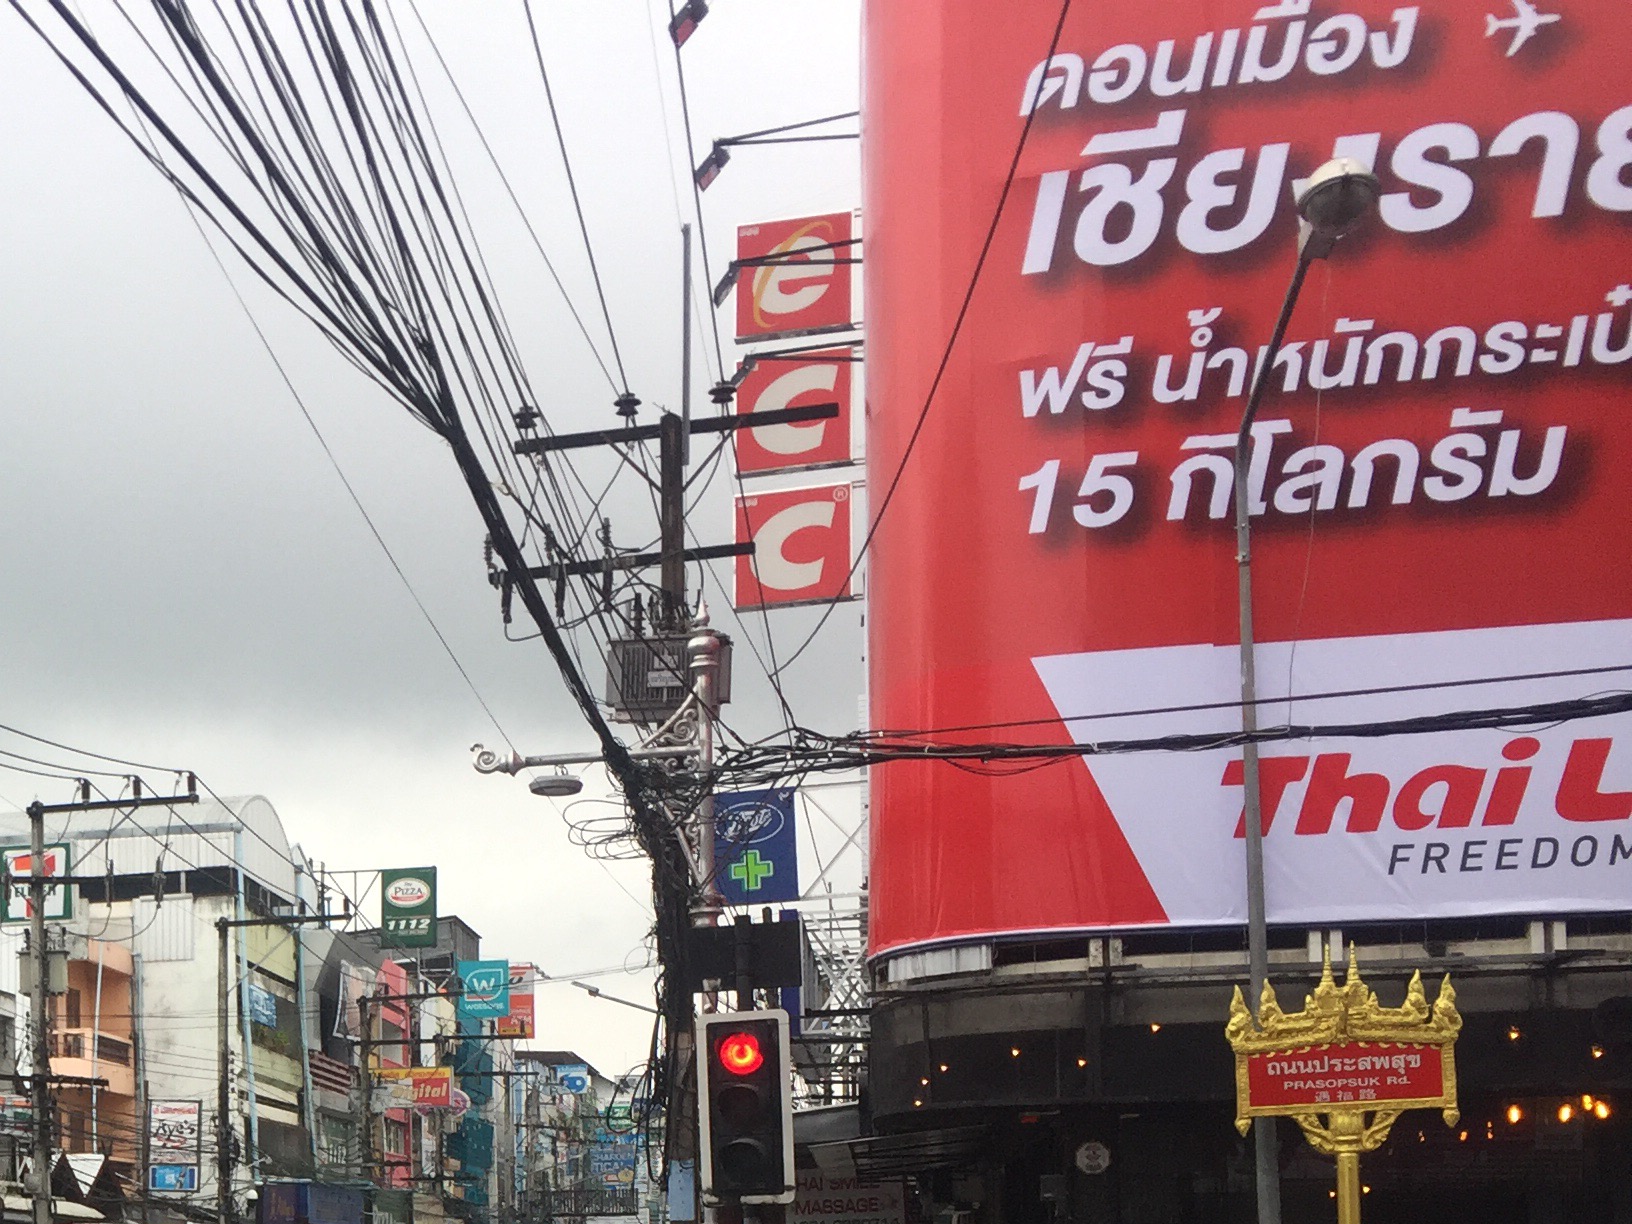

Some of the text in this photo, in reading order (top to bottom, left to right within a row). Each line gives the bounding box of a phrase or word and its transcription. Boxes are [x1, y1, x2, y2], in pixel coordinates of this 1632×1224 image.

[1019, 336, 1135, 418] ฟรี
[1017, 408, 1568, 535] 15 กิโลกรัม
[1220, 737, 1542, 840] Thai
[387, 918, 431, 931] 1112
[1283, 1076, 1381, 1090] PRASOPSUK
[796, 1176, 824, 1192] HAI
[794, 1197, 879, 1215] MASSAGE
